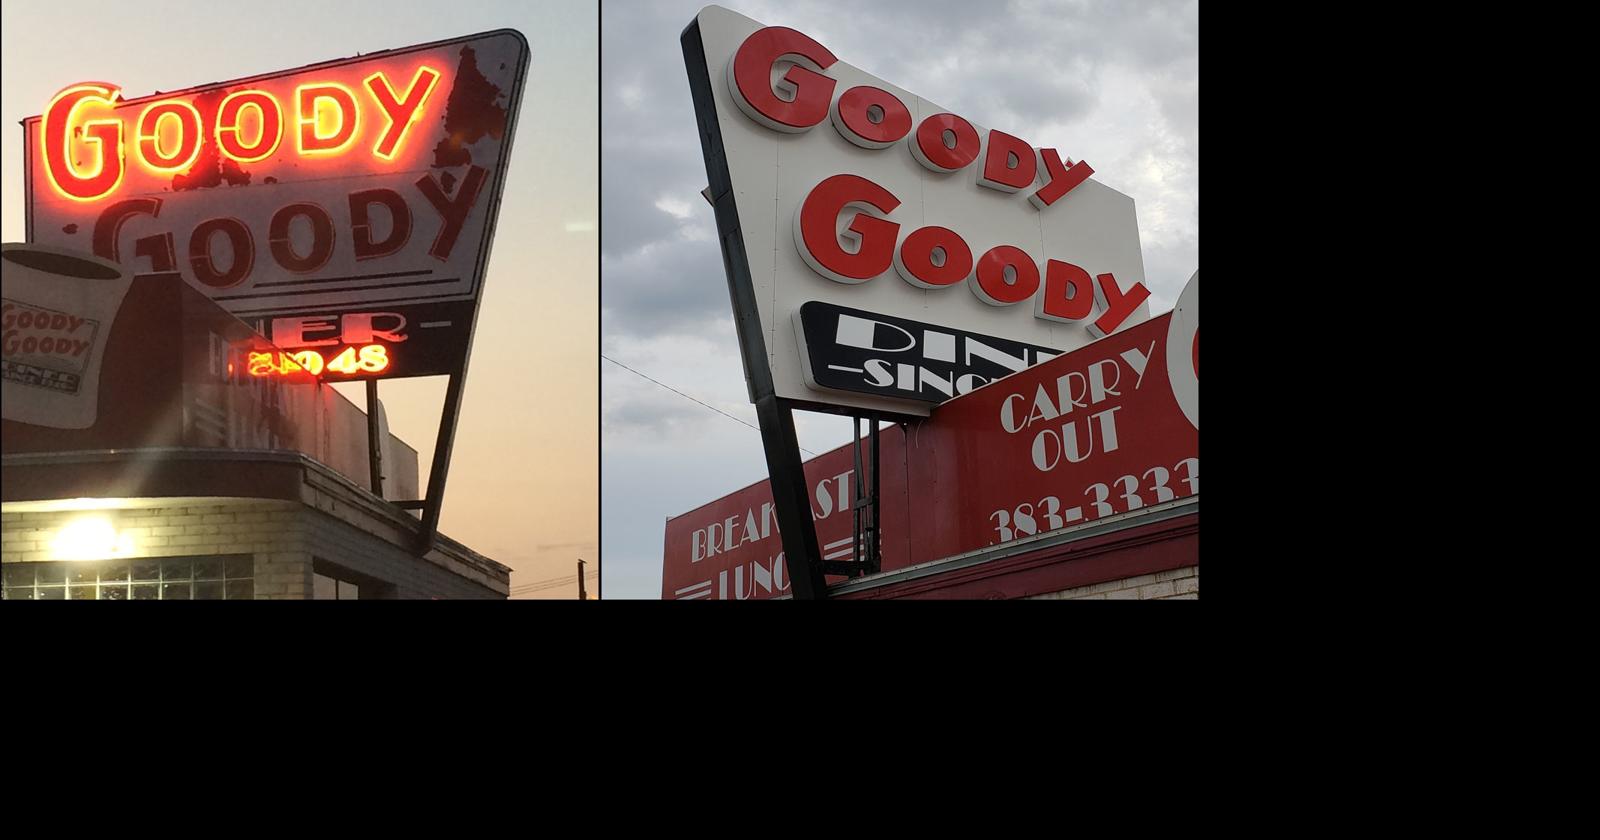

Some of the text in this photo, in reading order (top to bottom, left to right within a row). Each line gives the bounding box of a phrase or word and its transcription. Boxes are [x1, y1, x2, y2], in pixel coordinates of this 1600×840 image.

[41, 66, 441, 201] GOODY
[732, 26, 1095, 208] GOODY
[92, 165, 491, 289] GOODY
[798, 174, 1151, 336] GOODY
[2, 330, 90, 357] GOODY
[836, 313, 1060, 374] DIN
[863, 358, 1000, 397] SINC
[1000, 340, 1156, 434] CARRY
[1031, 406, 1122, 472] OUT
[989, 457, 1199, 546] 383-3333
[719, 552, 791, 600] LUNC
